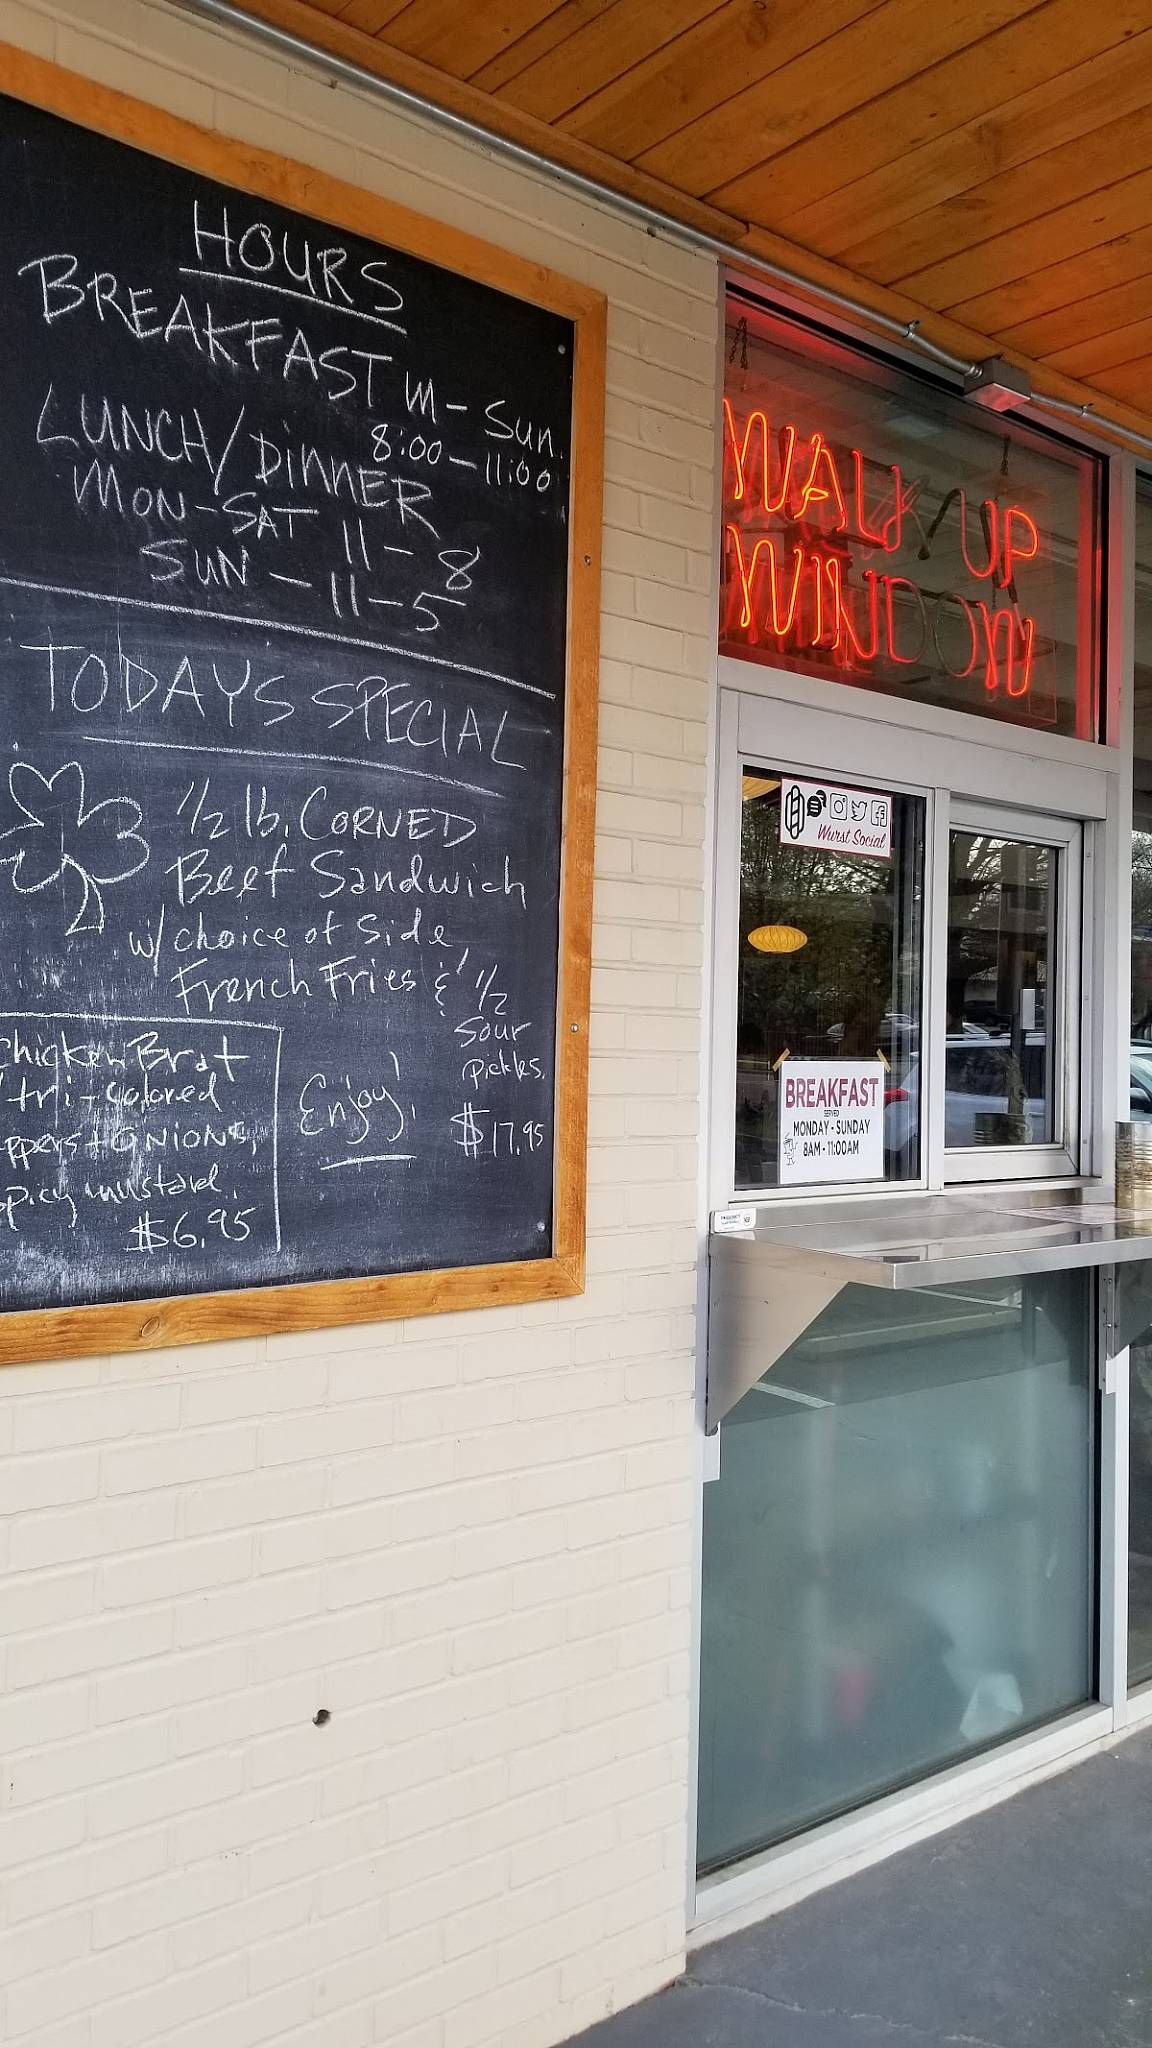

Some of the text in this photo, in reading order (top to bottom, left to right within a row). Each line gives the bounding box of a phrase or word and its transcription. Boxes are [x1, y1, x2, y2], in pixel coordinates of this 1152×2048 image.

[193, 200, 403, 312] HOURS
[18, 254, 392, 408] BREAKFAST
[957, 487, 1039, 589] UP
[438, 545, 480, 592] 8
[726, 523, 1035, 697] WINDOW
[20, 626, 526, 771] TODAYS SPECIAL
[817, 823, 887, 848] Wurst Social
[165, 843, 527, 909] Beef Sandwich
[174, 911, 288, 951] choice
[304, 911, 342, 945] of
[171, 958, 312, 1014] French
[319, 955, 417, 1000] Fries
[127, 1031, 250, 1082] Brat
[785, 1077, 879, 1108] BREAKFAST
[450, 1102, 545, 1160] $17.95
[793, 1119, 829, 1137] MONDAY
[836, 1119, 871, 1135] SUNDAY
[803, 1142, 820, 1157] 8AM
[827, 1140, 859, 1155] 11:00AM
